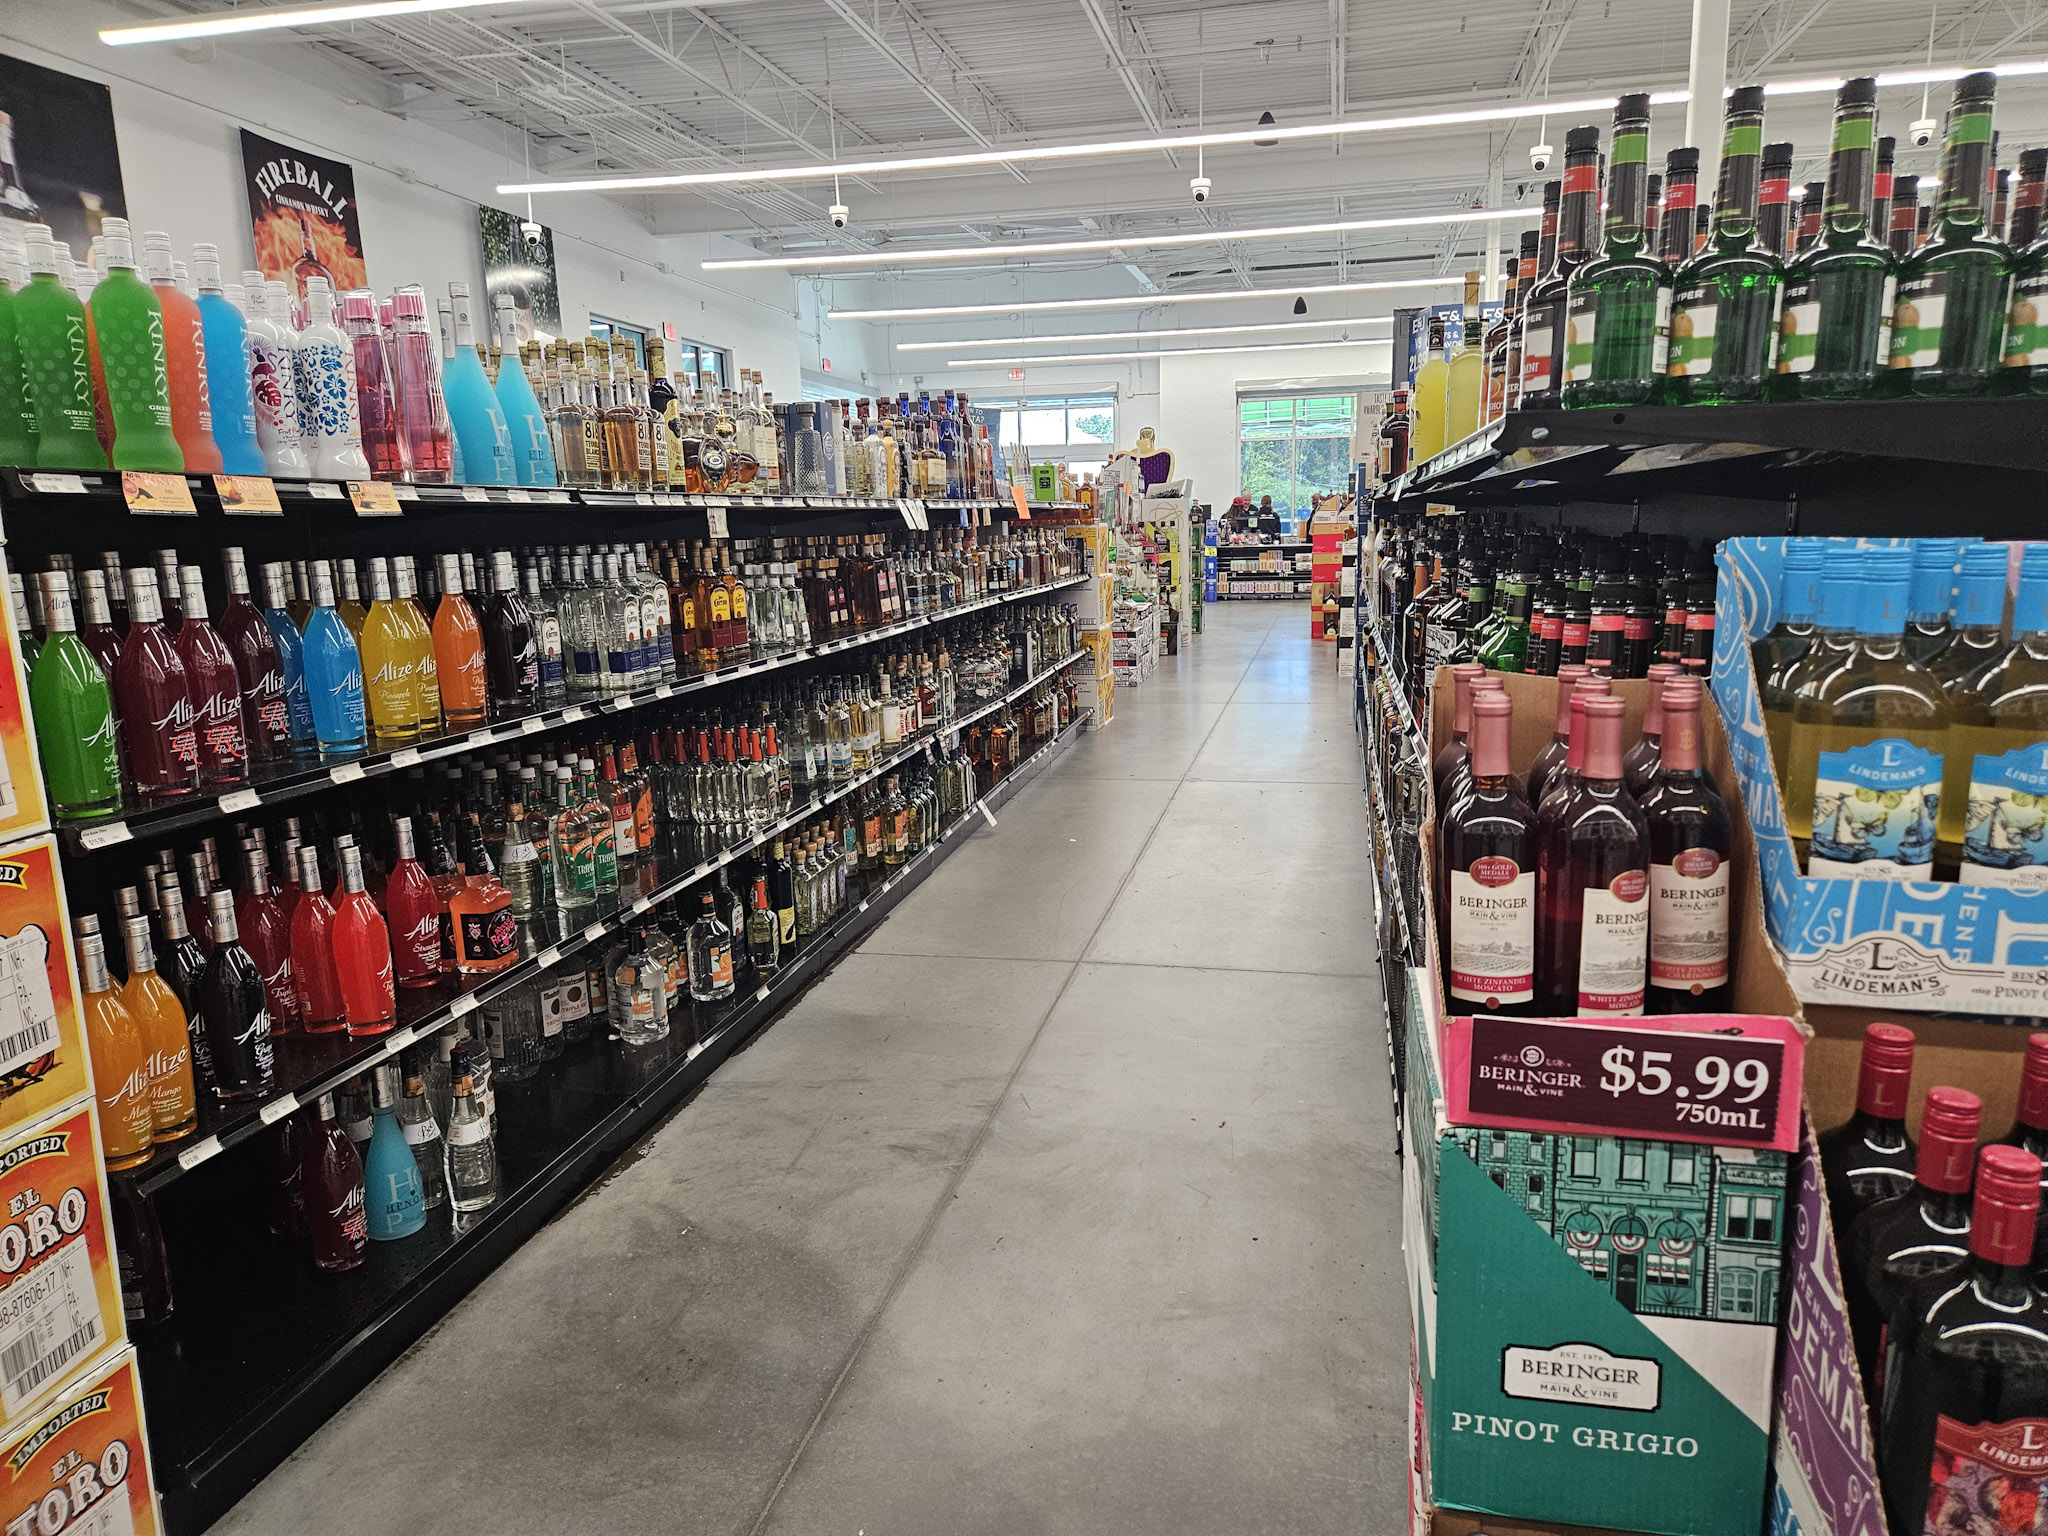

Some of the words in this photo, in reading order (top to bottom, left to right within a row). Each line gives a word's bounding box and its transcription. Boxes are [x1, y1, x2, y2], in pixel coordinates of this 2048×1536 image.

[255, 159, 347, 220] FIREBALL
[275, 194, 305, 211] CINNAMON
[305, 202, 329, 217] WHISKY
[147, 308, 169, 402] KINKY
[370, 660, 414, 686] Alizé
[415, 653, 437, 675] Aliz
[195, 690, 243, 722] Alizé
[1882, 745, 1901, 766] L
[1848, 763, 1926, 781] LINDEMAN'S
[2005, 766, 2048, 785] LINDE
[1459, 895, 1528, 909] BERINGER
[1660, 885, 1726, 899] BERINGER
[1489, 911, 1499, 921] &
[1693, 901, 1703, 910] &
[1595, 911, 1648, 925] BERINGE
[1868, 942, 1896, 971] L
[1457, 974, 1482, 983] WHITE
[1484, 976, 1527, 985] ZINFANDEL
[1473, 984, 1513, 992] MOSCATO
[1820, 969, 1940, 994] LINDEMAN'S
[2011, 971, 2034, 980] BIN
[2034, 969, 2048, 987] 8
[1589, 994, 1616, 1003] WHITE
[1994, 985, 2040, 999] PINOT
[1479, 1063, 1583, 1089] BERINGER
[1599, 1044, 1769, 1104] $5.99
[103, 1066, 149, 1108] Aliz
[149, 1085, 182, 1099] Mango
[1497, 1083, 1523, 1093] MAIN
[1523, 1083, 1538, 1096] &
[1539, 1087, 1564, 1097] VINE
[122, 1105, 151, 1122] Mang
[1675, 1102, 1765, 1129] 750mL
[9, 1188, 40, 1218] EL
[0, 1188, 86, 1272] ORO
[1797, 1262, 1836, 1346] HENRY
[1521, 1358, 1641, 1385] BERINGER
[1540, 1384, 1570, 1394] MAIN
[1571, 1383, 1589, 1398] &
[1590, 1388, 1619, 1399] VINE
[15, 1394, 104, 1465] IMPORTED
[1452, 1411, 1559, 1442] PINOT
[1572, 1426, 1698, 1458] GRIGIO
[2020, 1425, 2045, 1450] L
[52, 1450, 82, 1482] EL
[5, 1441, 129, 1536] TORO
